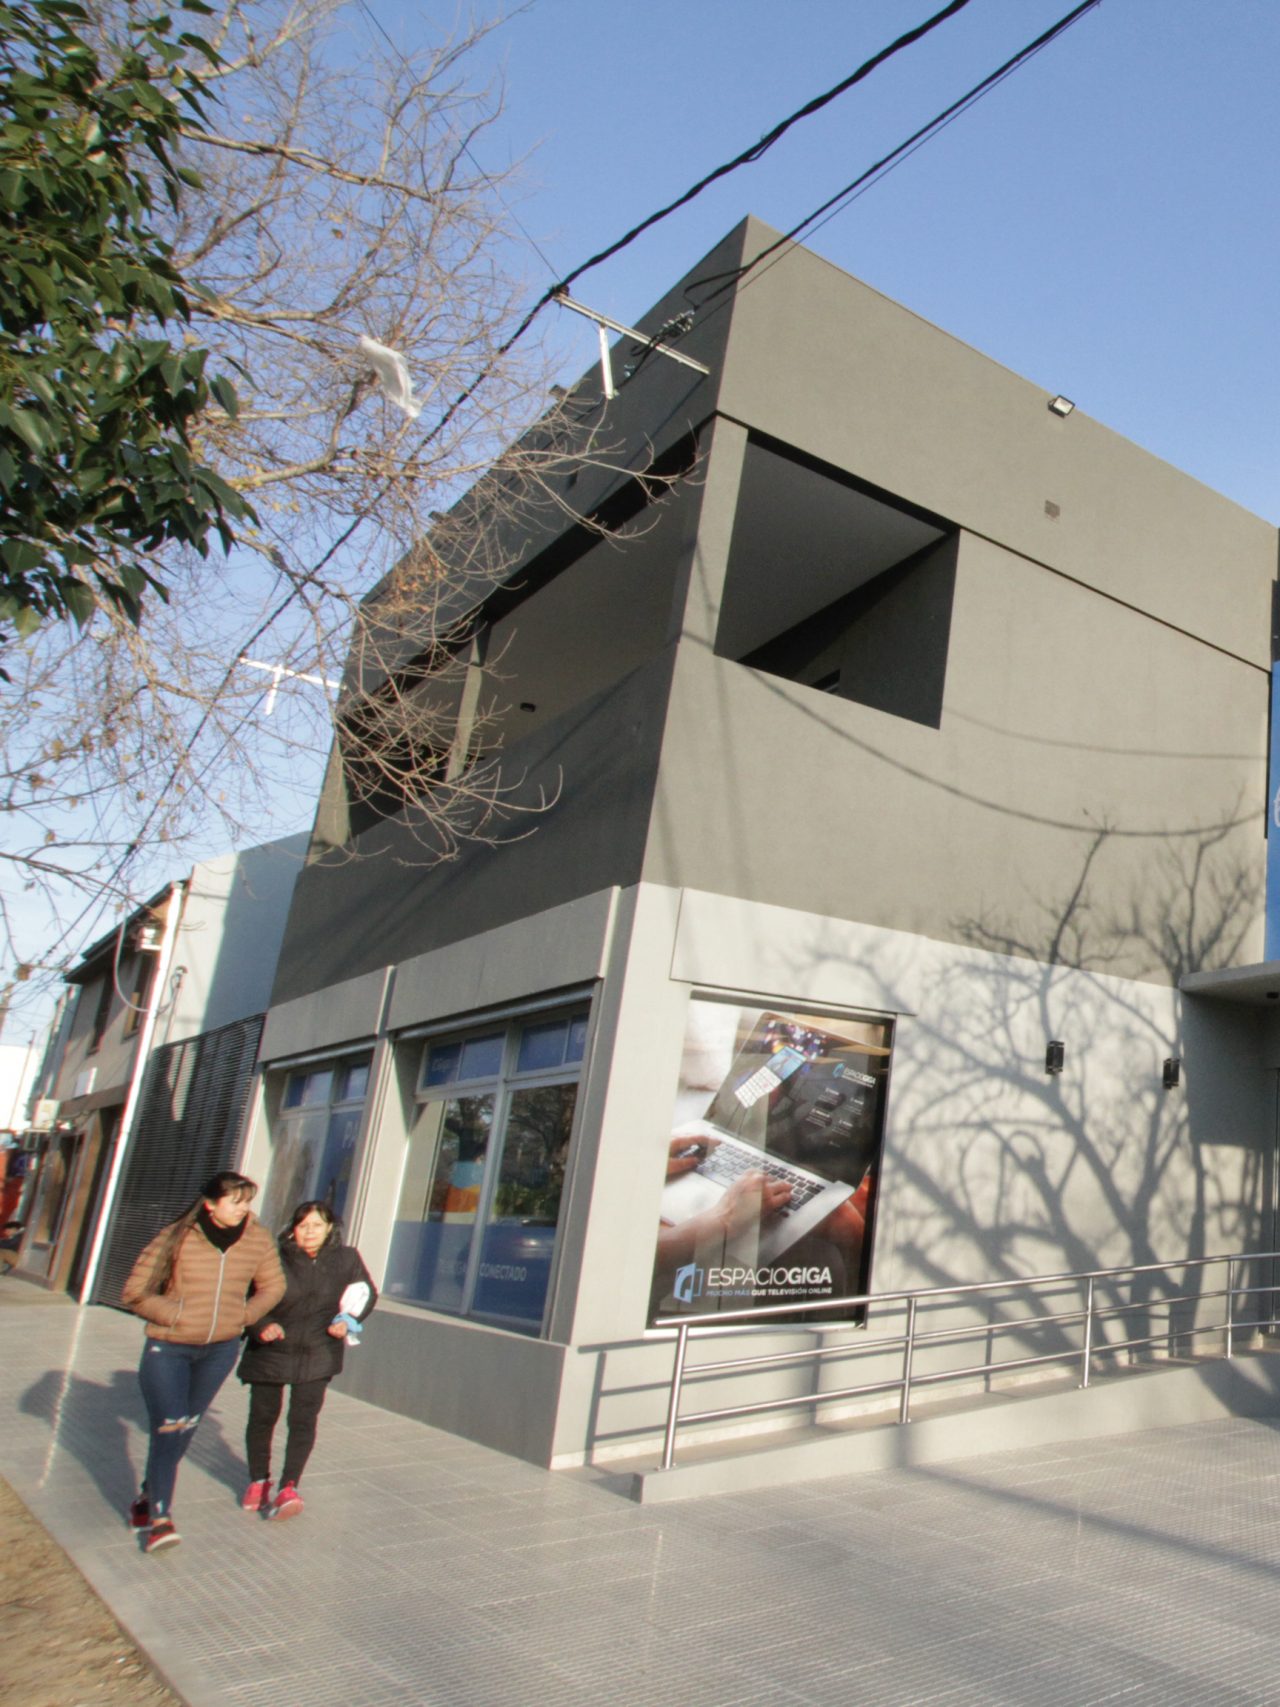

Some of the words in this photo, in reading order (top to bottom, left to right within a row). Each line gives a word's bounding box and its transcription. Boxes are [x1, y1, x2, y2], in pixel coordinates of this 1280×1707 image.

[707, 1266, 833, 1287] ESPACIOGIGA
[751, 1288, 767, 1297] QUE
[768, 1287, 807, 1296] TELEVISIÓN
[808, 1286, 833, 1295] ONLINE
